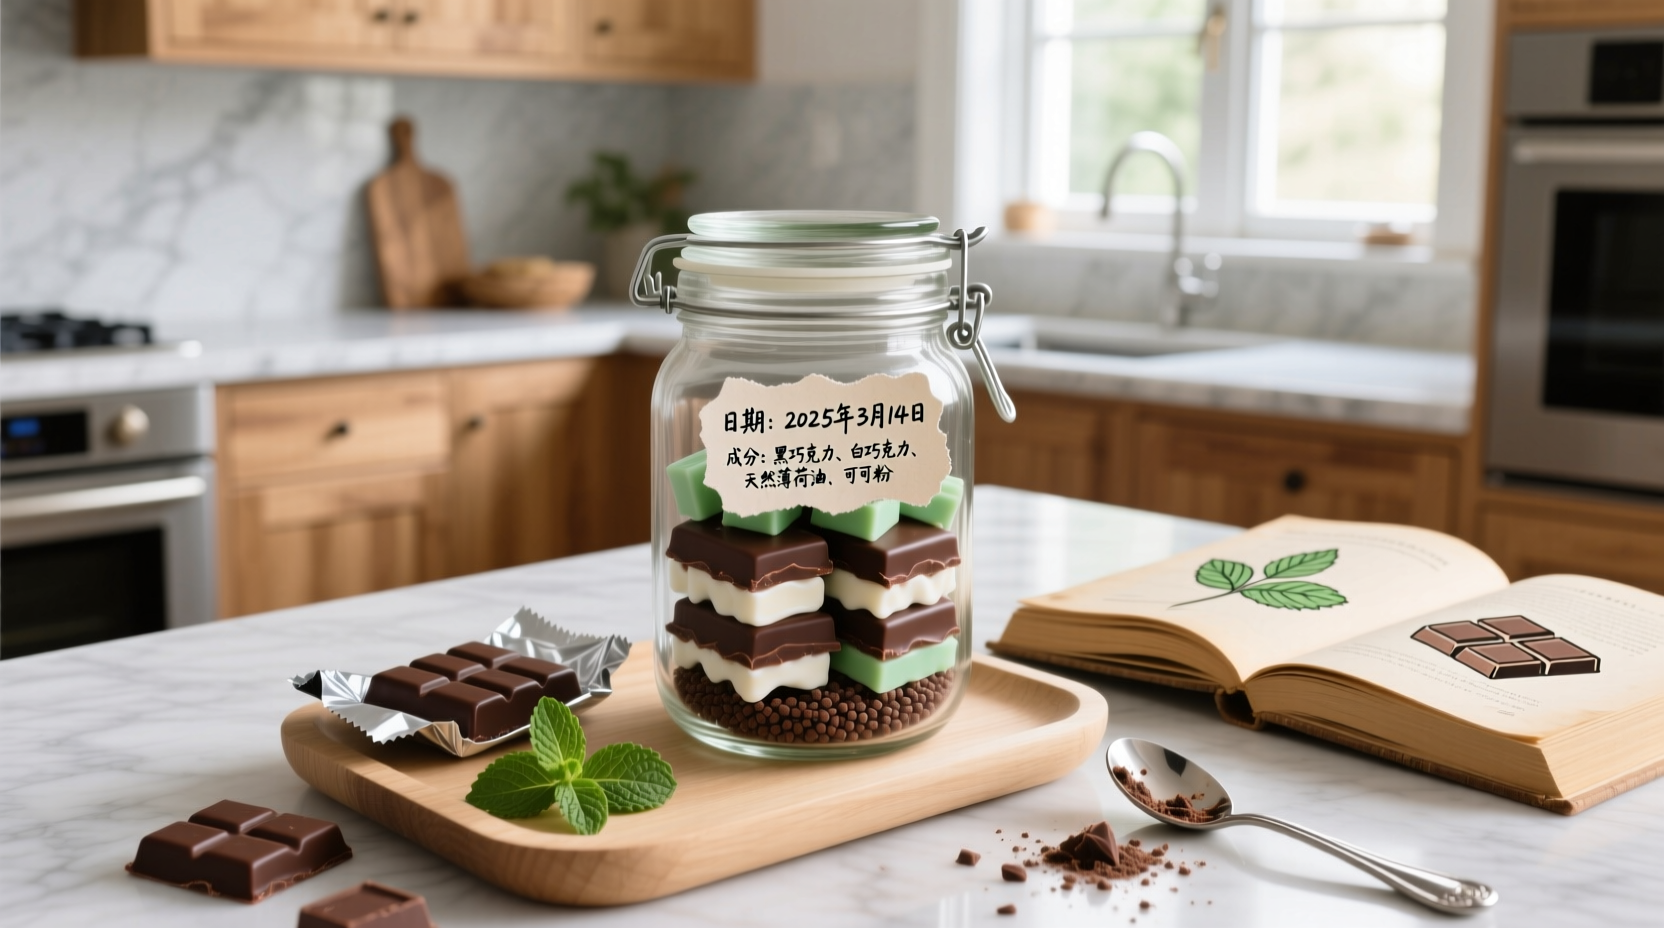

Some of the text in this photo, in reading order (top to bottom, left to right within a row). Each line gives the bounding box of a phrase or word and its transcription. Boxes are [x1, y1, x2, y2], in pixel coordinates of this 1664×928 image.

[724, 402, 924, 434] 日期：2025年3月14日
[744, 464, 894, 489] 天然薄荷油、可可粉
